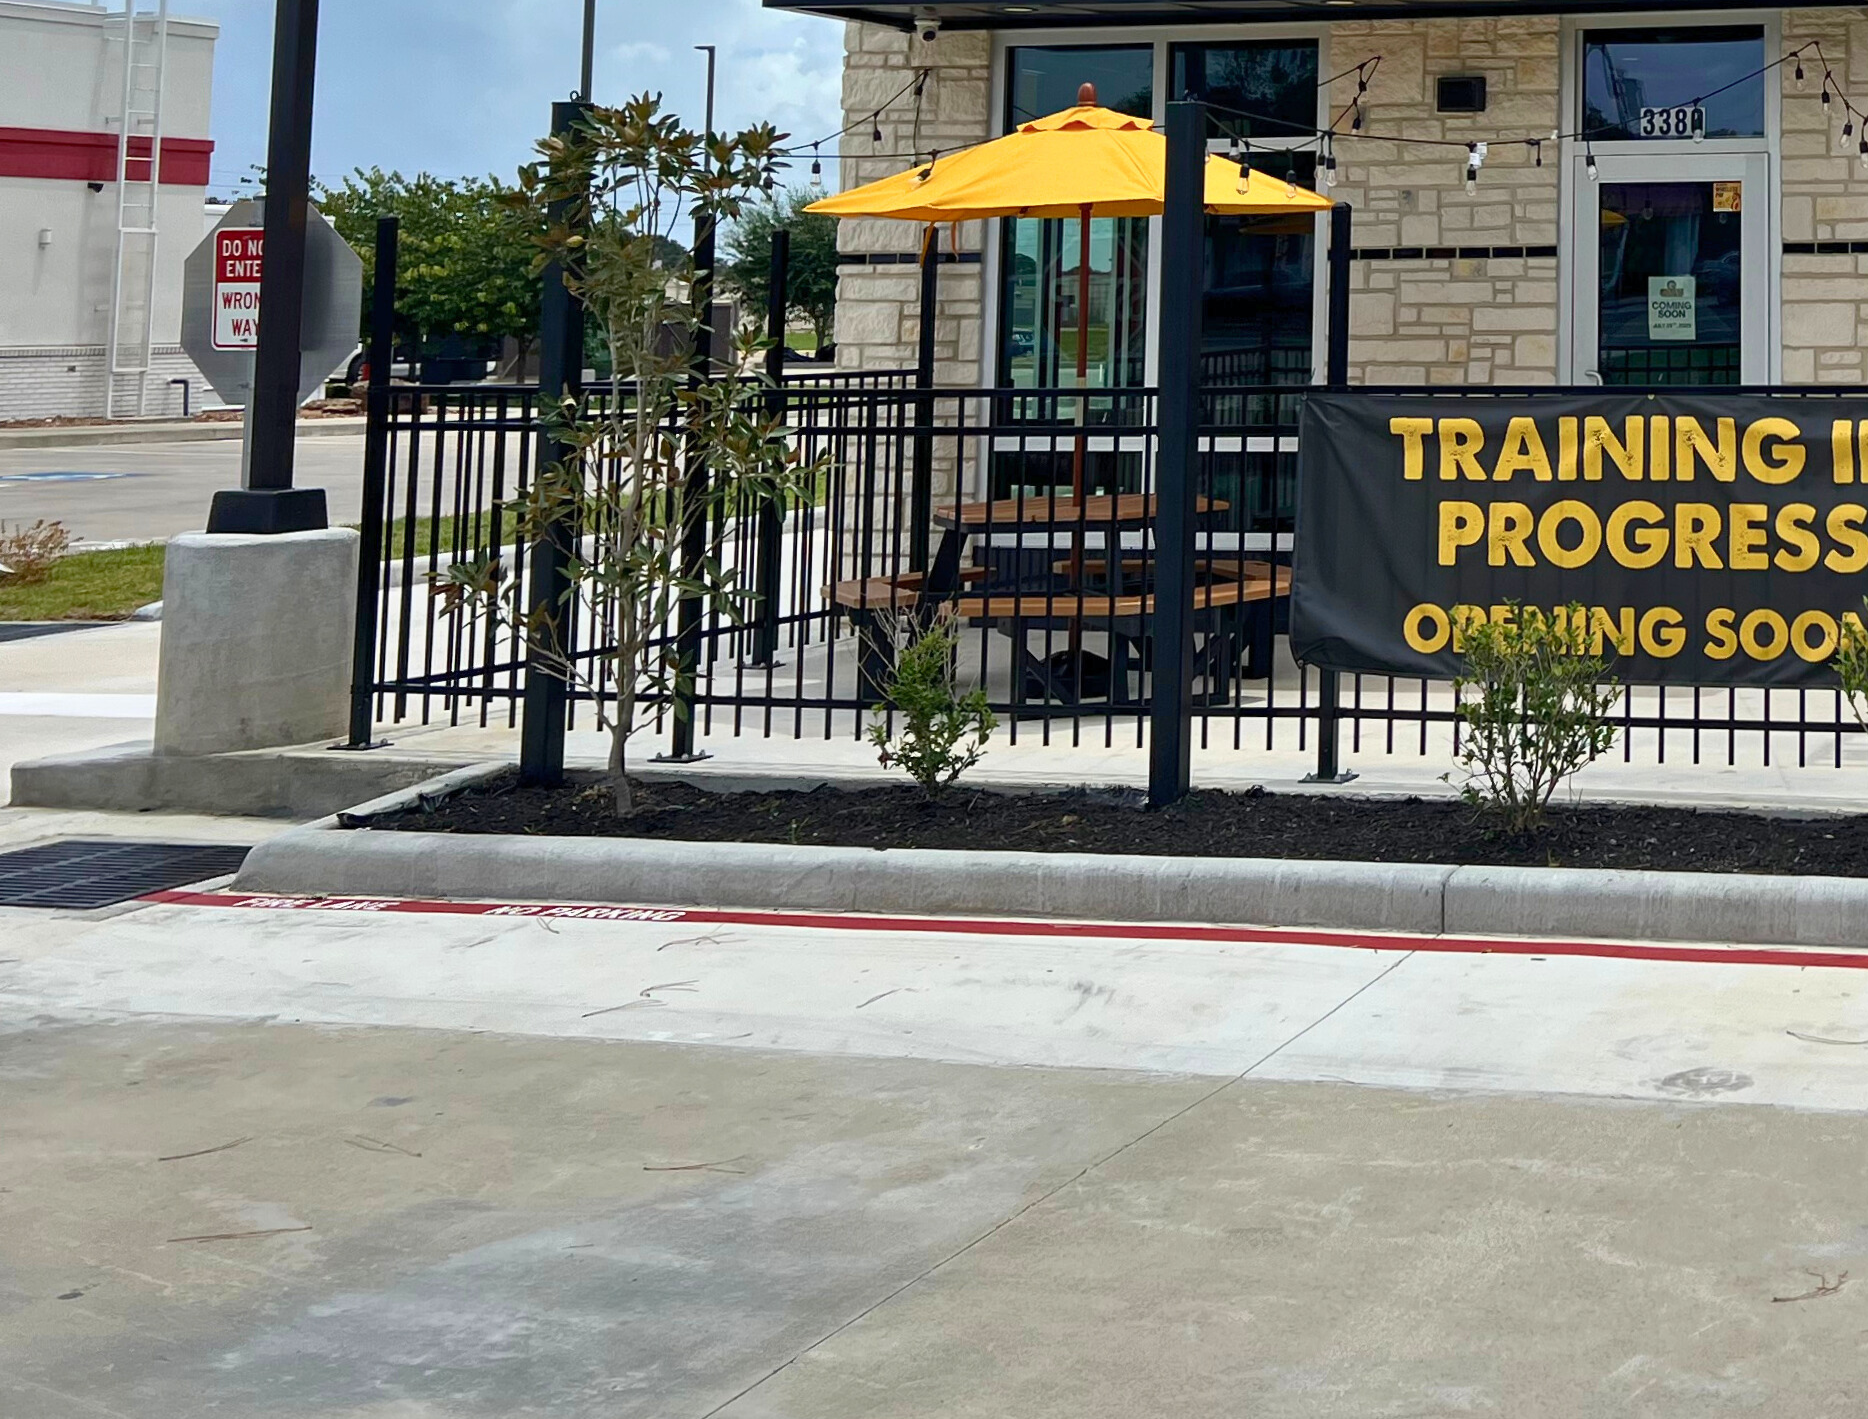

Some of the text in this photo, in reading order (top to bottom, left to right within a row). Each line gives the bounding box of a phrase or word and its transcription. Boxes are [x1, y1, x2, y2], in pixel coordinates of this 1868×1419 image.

[222, 240, 264, 257] DO NO
[226, 260, 262, 277] ENTE
[222, 291, 261, 309] WRON
[1652, 301, 1692, 310] COMING
[1658, 310, 1686, 318] SOON
[1389, 414, 1807, 485] TRAINING
[1403, 602, 1687, 659] OPENING
[232, 897, 400, 911] FIRE LANE
[483, 906, 686, 921] NO PARKING
